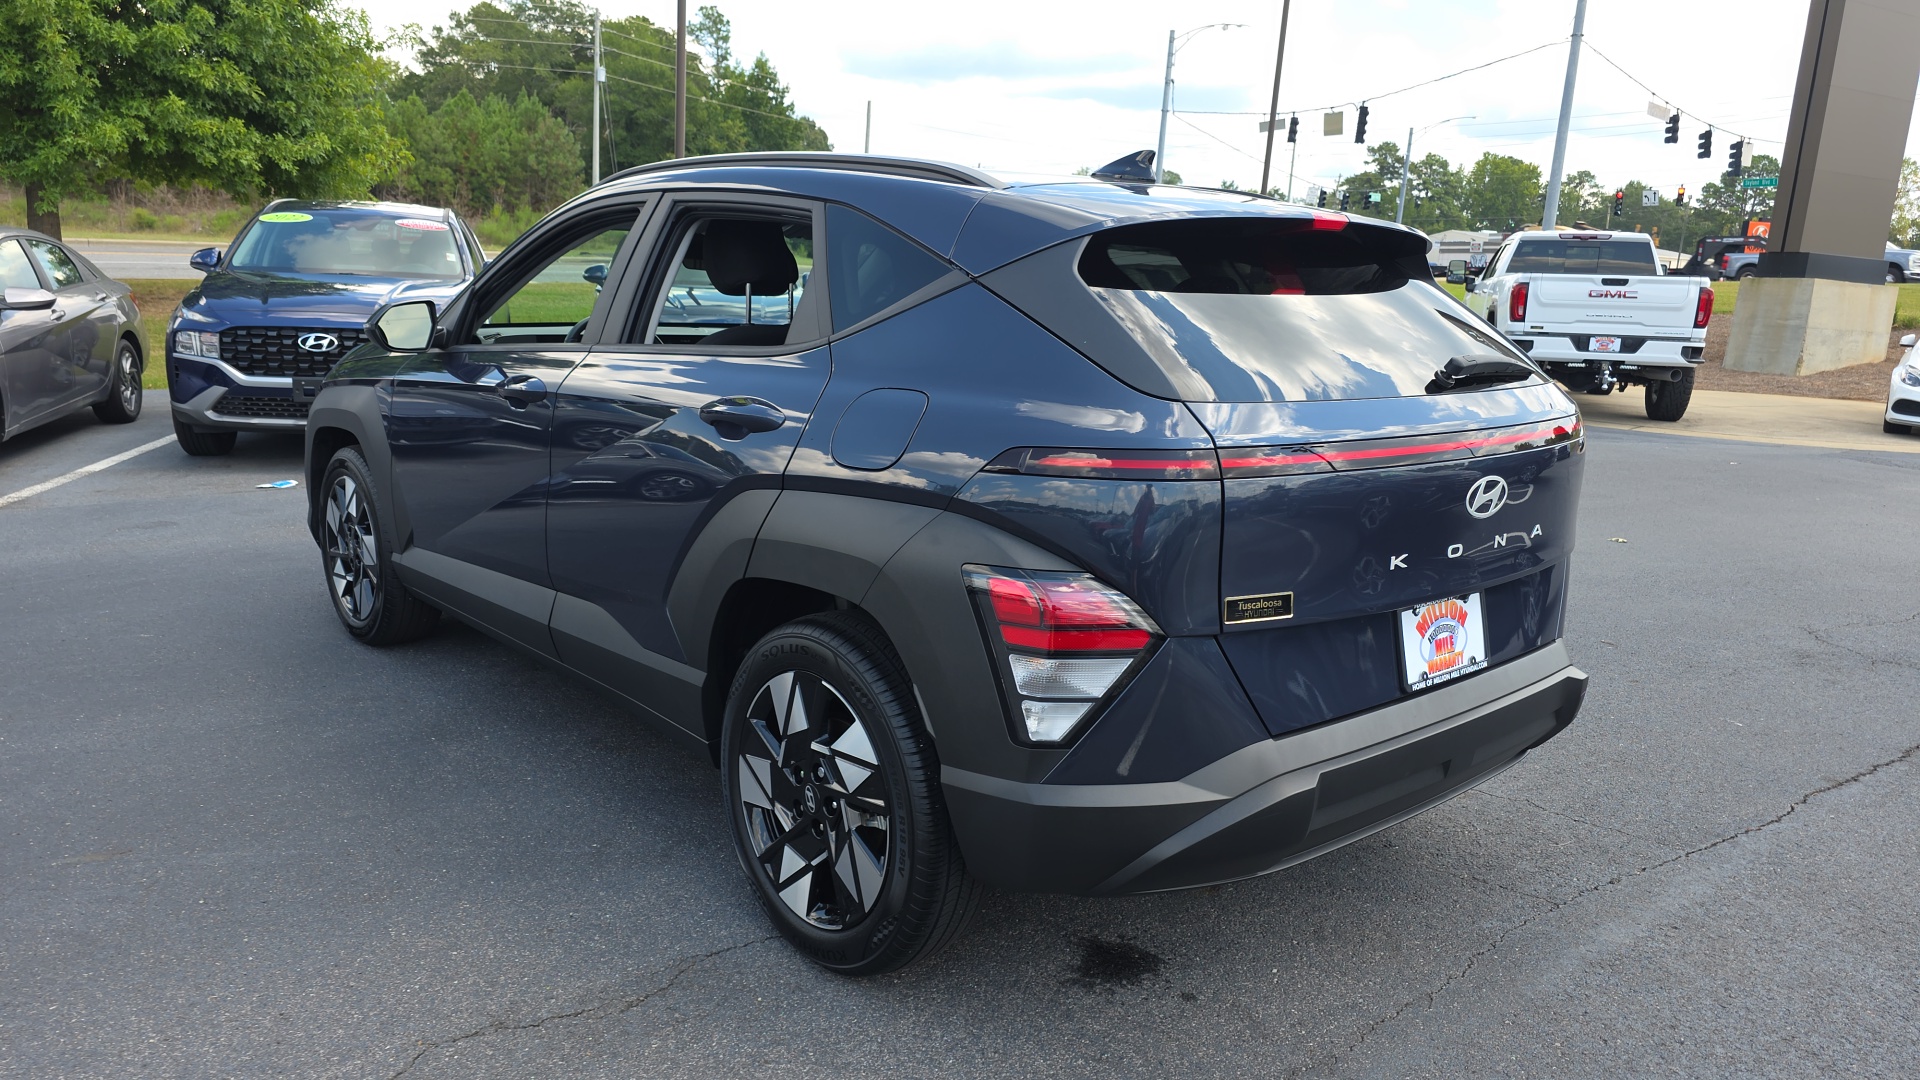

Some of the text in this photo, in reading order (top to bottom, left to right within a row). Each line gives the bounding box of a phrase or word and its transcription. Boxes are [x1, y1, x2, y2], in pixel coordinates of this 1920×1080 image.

[1588, 289, 1639, 299] GMC
[1389, 524, 1543, 571] KONA
[1237, 599, 1283, 611] Tuscaloosa
[1244, 607, 1275, 618] HYUNDAI
[1415, 599, 1469, 639] MILLION
[760, 643, 810, 662] SOLUS
[1434, 635, 1455, 656] MILE
[1426, 651, 1465, 676] WARRANTY
[1411, 680, 1427, 692] HOME
[1426, 678, 1433, 687] OF
[1433, 672, 1451, 684] MILLION
[1450, 669, 1460, 679] MILE
[897, 814, 907, 848] R18
[897, 847, 907, 879] 95V
